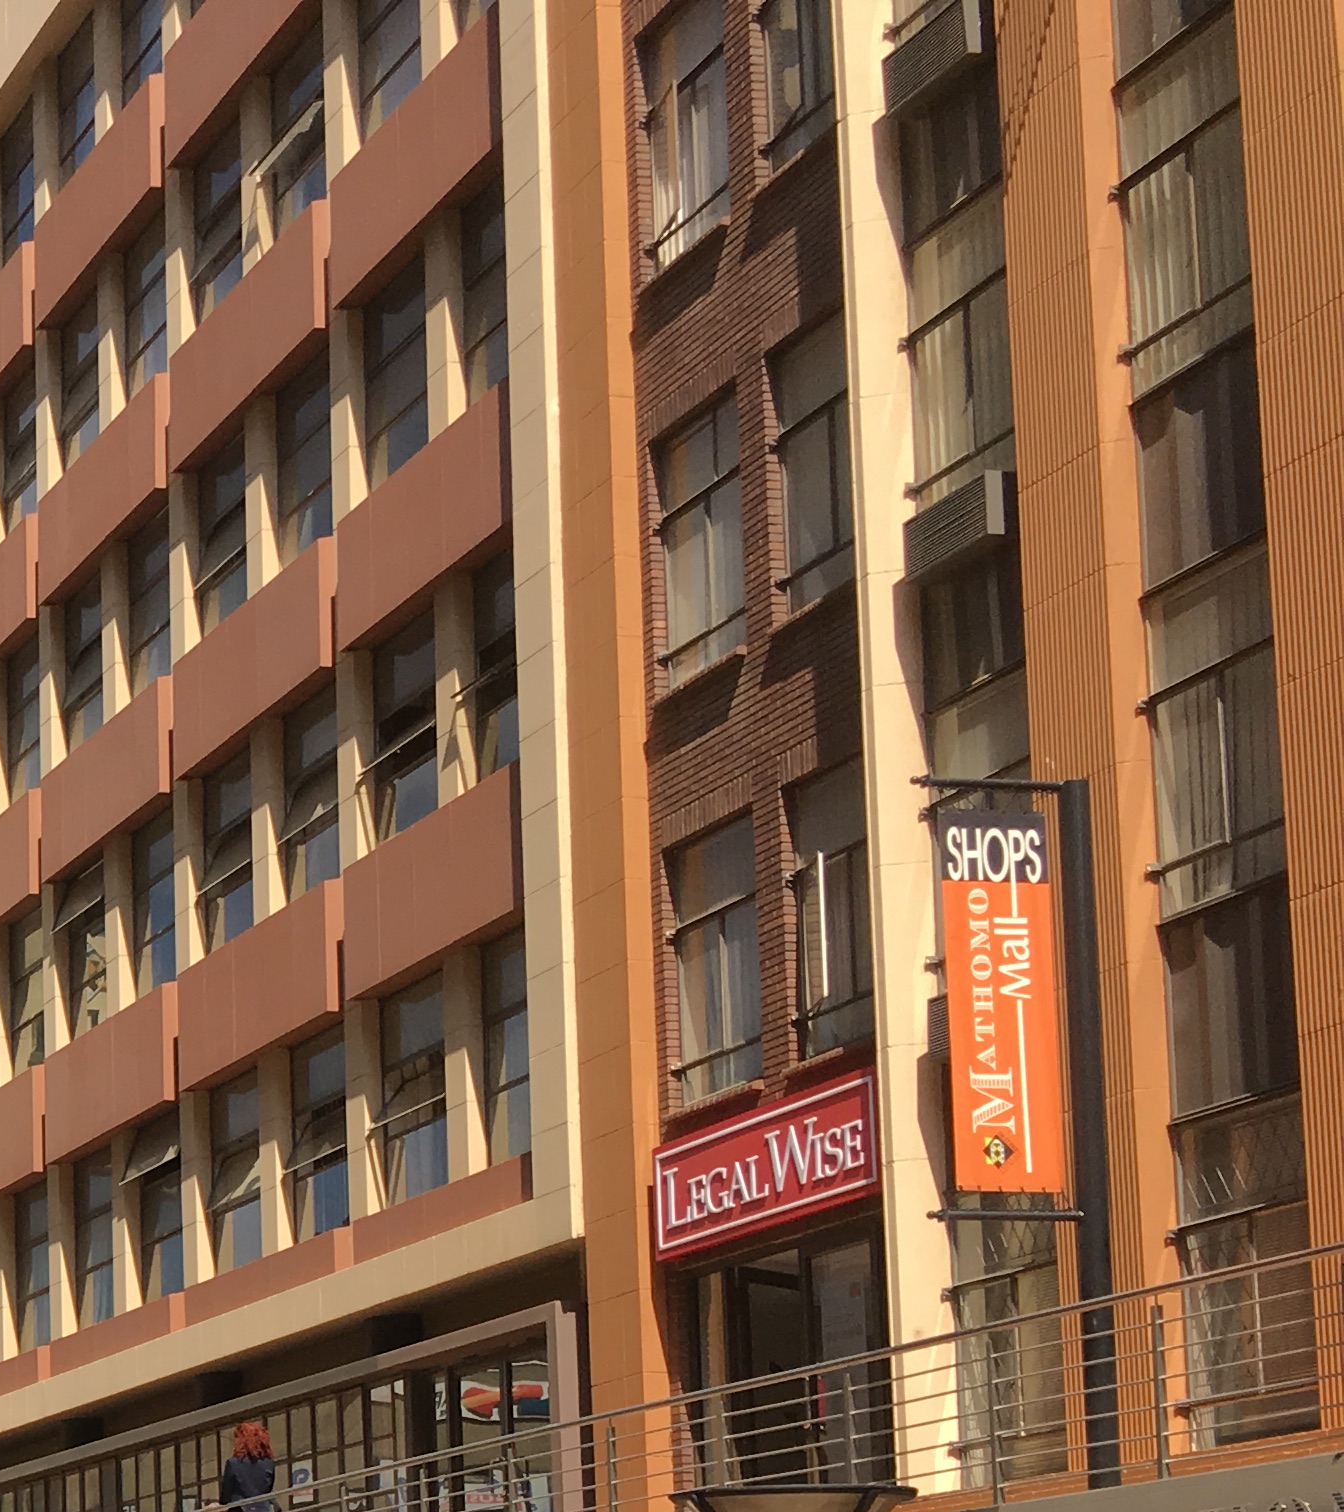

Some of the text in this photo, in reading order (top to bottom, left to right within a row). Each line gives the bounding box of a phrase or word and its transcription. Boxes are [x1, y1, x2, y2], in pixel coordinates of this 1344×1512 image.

[947, 826, 1042, 884] SHOPS
[994, 916, 1032, 1000] Mall
[968, 888, 1016, 1135] MATHOMO
